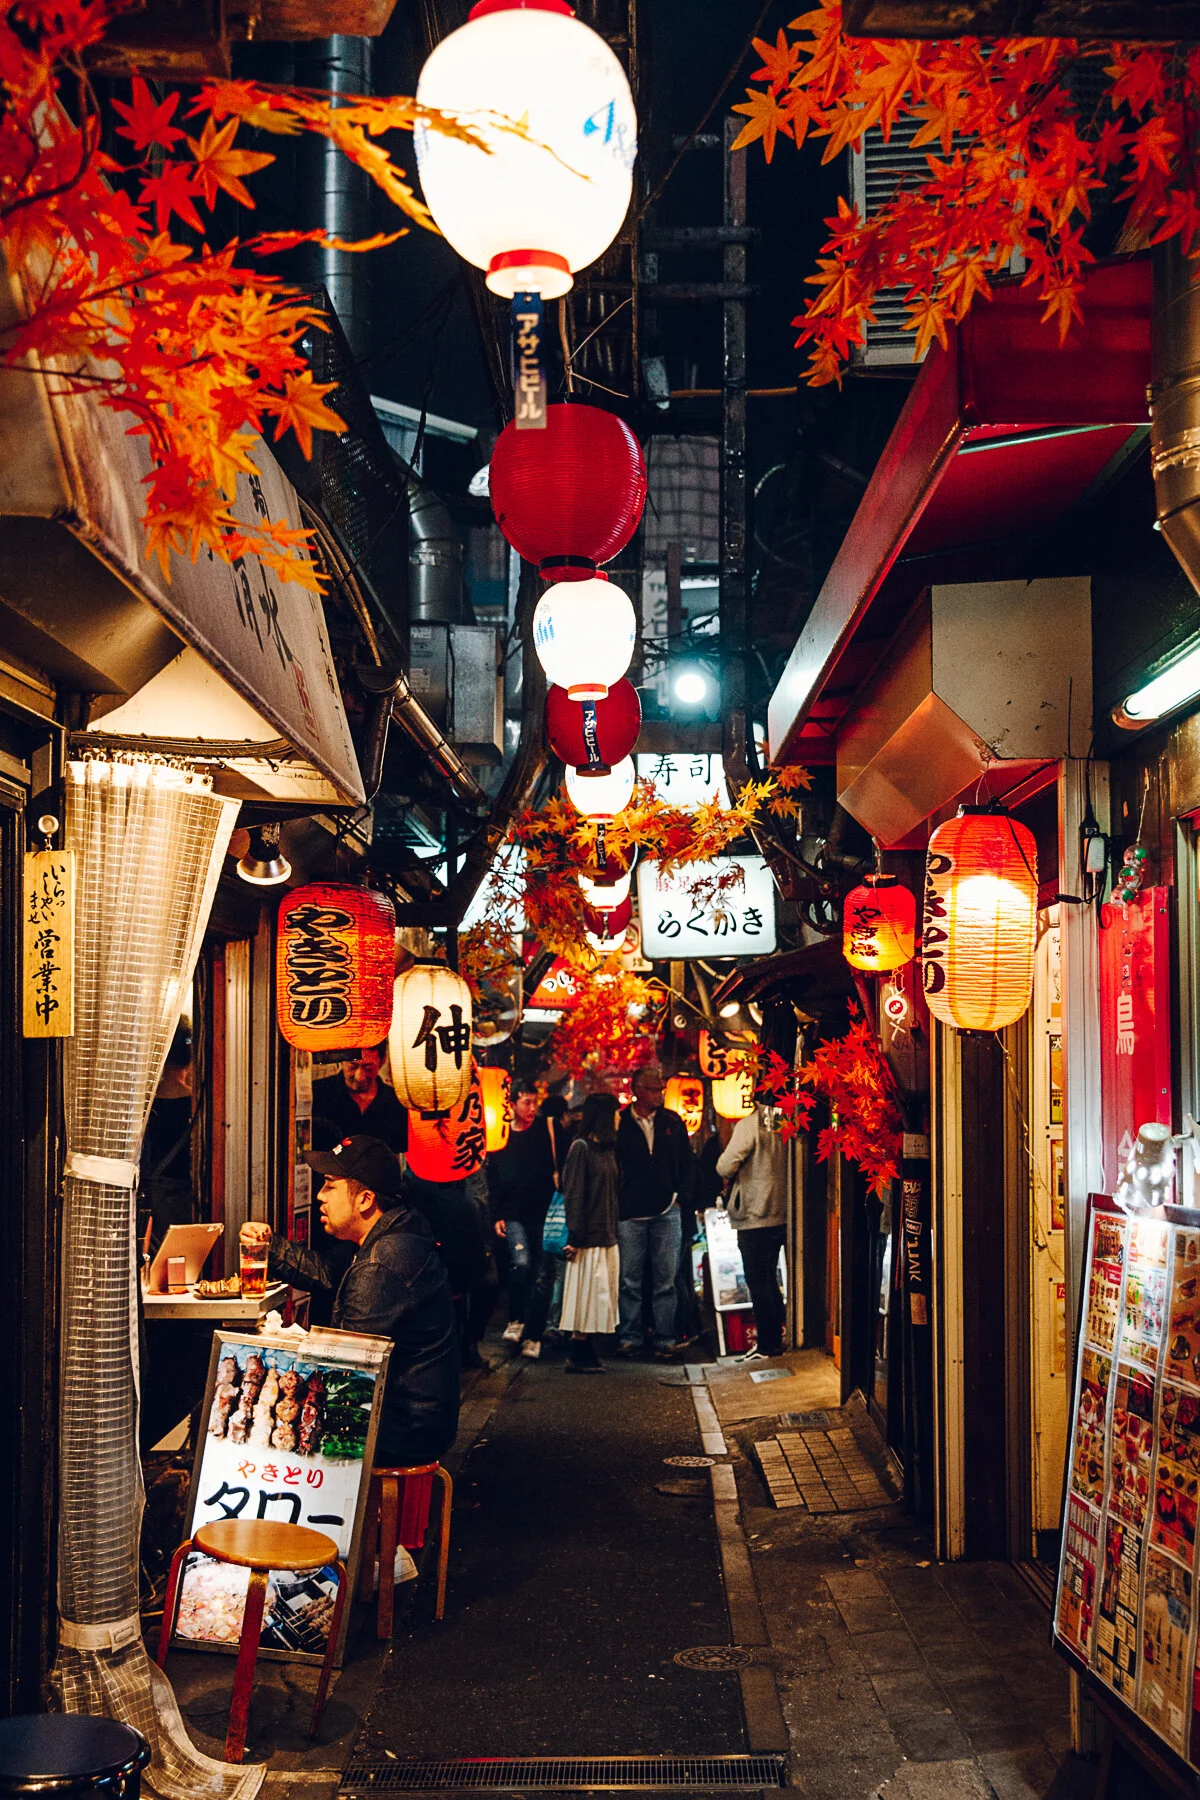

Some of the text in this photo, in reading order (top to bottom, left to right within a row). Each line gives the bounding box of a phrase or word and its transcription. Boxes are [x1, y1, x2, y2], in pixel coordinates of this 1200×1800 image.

[516, 313, 543, 420] アサヒビール
[583, 709, 600, 763] アサヒビール
[650, 754, 712, 786] 寿司
[32, 928, 62, 1026] 営業中
[284, 904, 356, 1030] やきとり
[451, 1064, 484, 1171] 乃家
[237, 1459, 324, 1489] やきとり
